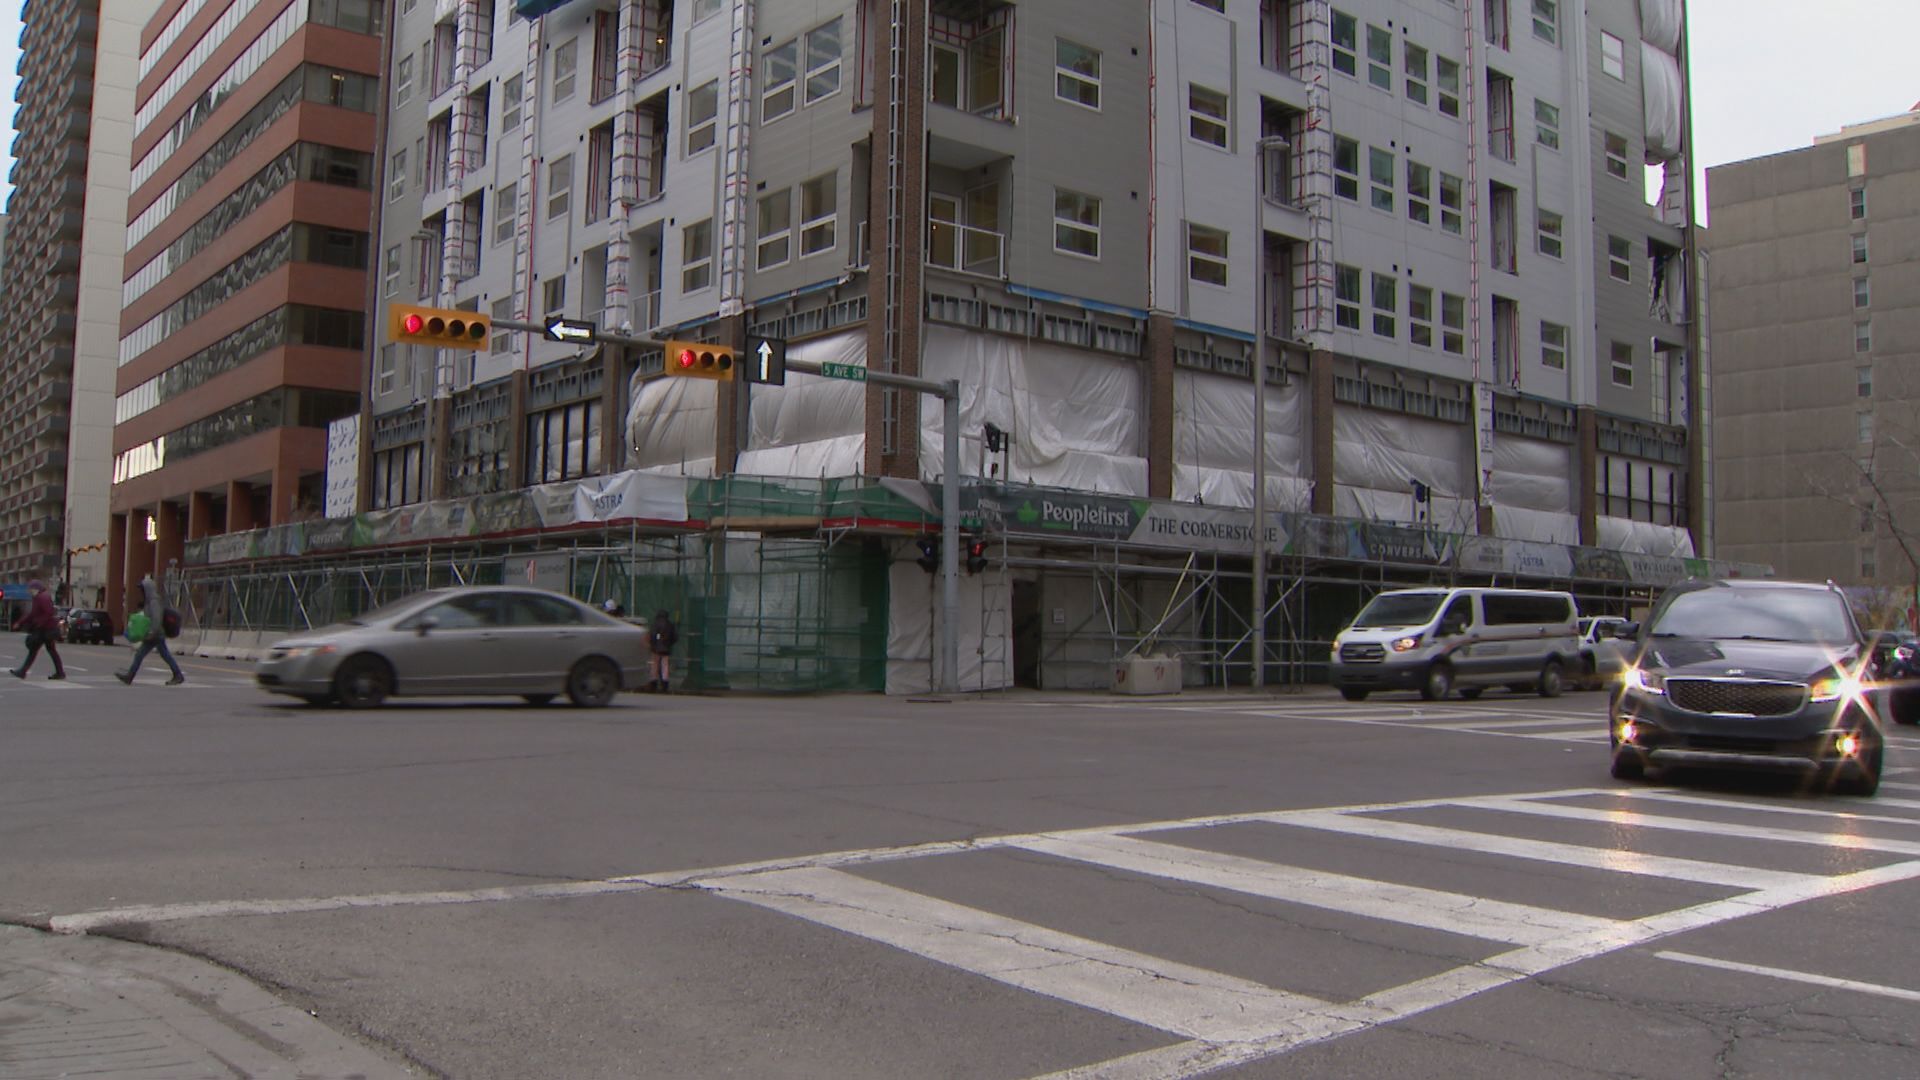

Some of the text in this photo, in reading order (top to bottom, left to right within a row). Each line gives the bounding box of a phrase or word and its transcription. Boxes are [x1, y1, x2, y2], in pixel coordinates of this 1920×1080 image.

[824, 365, 865, 379] 5 AVE SW
[594, 493, 623, 510] ASTRA
[1042, 500, 1129, 531] Peoplefirst
[1149, 516, 1177, 535] THE
